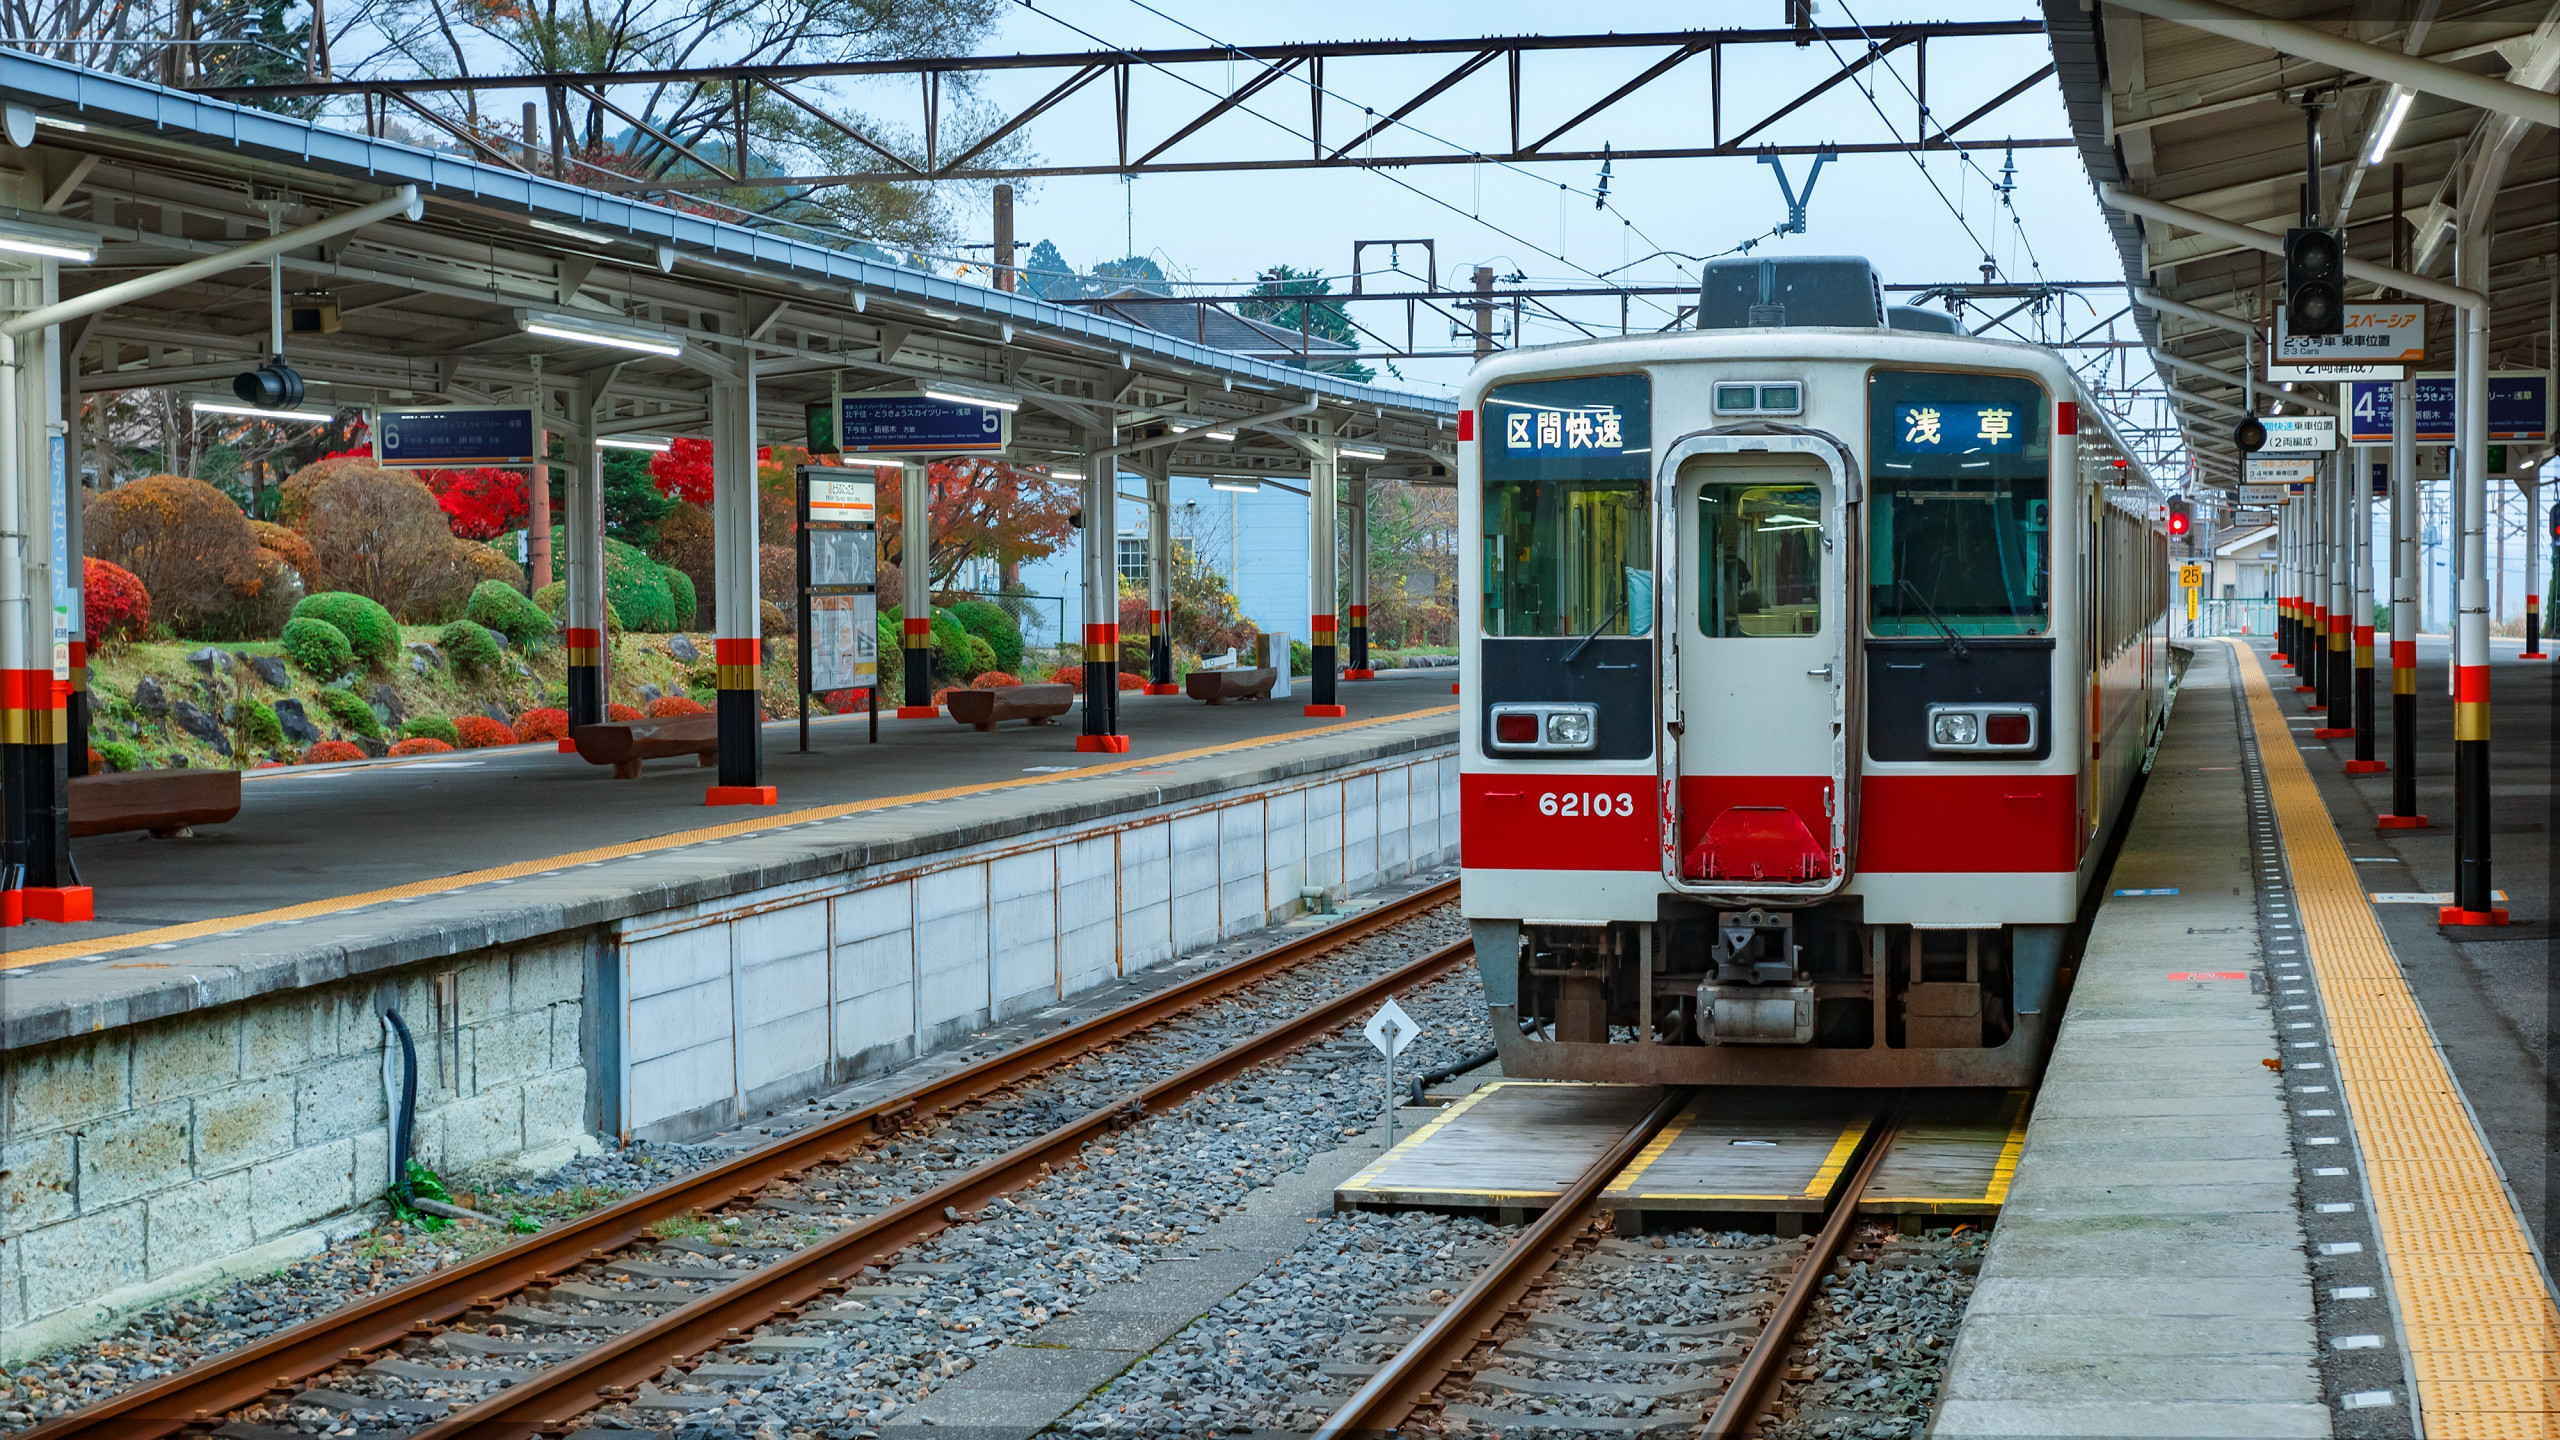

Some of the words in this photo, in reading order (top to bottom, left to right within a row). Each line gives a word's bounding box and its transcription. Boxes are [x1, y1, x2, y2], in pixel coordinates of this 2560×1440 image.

[2344, 313, 2417, 329] スペーシア
[2341, 334, 2391, 347] 乗車位置
[845, 408, 972, 419] 北千住・とうきょうスカイツリー・浅草
[982, 404, 999, 433] 5
[2354, 391, 2376, 423] 4
[384, 423, 400, 449] 6
[845, 425, 897, 434] 下今市・新栃木
[1507, 411, 1623, 450] 区間快速
[1905, 407, 2013, 446] 浅草
[2263, 421, 2333, 431] 間快速乗車位置
[51, 441, 66, 600] とうぶにっこう
[2183, 569, 2199, 584] 25
[1539, 792, 1634, 817] 62103
